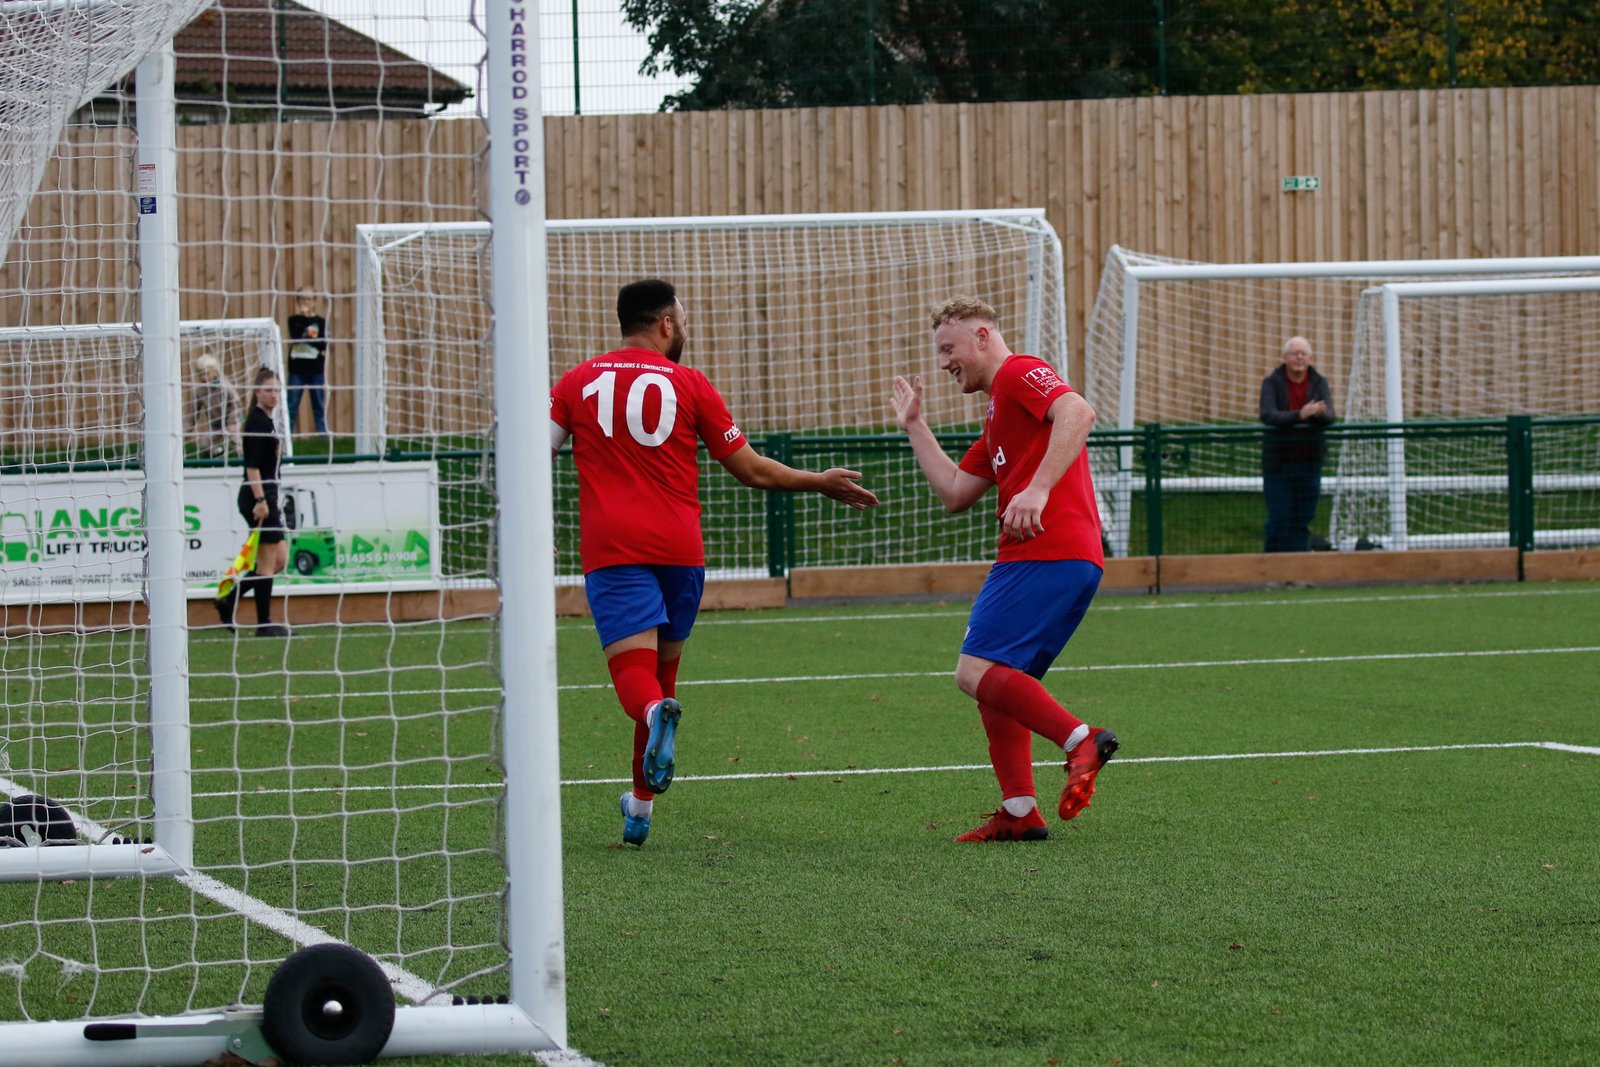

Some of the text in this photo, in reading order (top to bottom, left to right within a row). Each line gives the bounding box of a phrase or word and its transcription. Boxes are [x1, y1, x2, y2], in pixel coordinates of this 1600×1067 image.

[510, 8, 529, 185] HARROD SPORT
[641, 363, 674, 374] CONTRACTORS
[582, 371, 678, 447] 10
[47, 505, 201, 539] ANGS
[46, 542, 83, 555] LIFT
[336, 553, 371, 564] 01455
[12, 576, 42, 587] SALES
[51, 575, 73, 586] HIRE
[82, 574, 112, 584] PARTS
